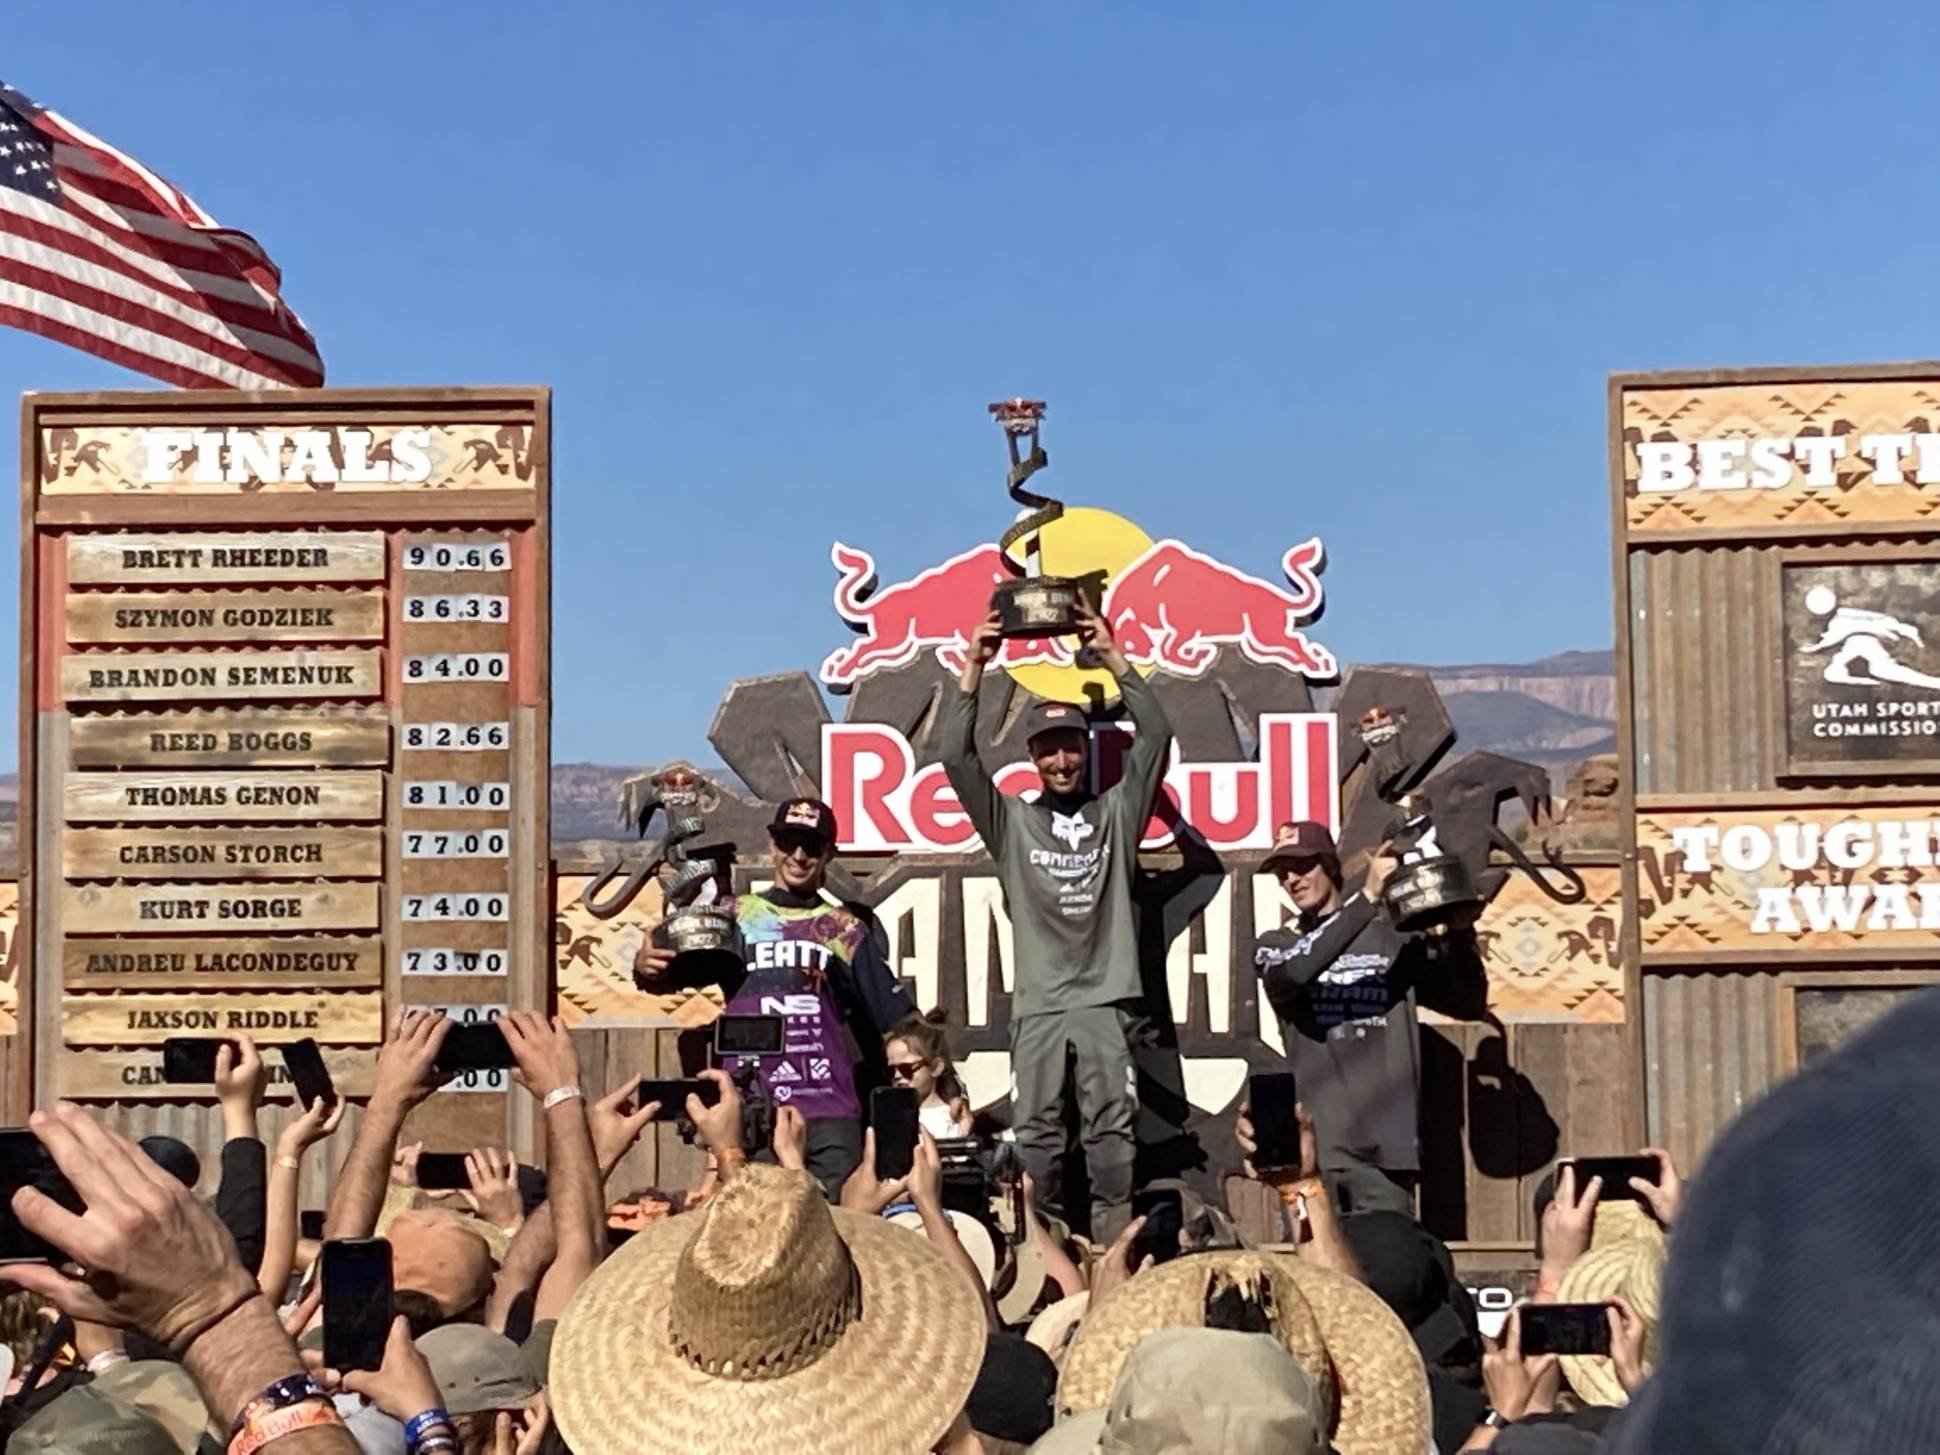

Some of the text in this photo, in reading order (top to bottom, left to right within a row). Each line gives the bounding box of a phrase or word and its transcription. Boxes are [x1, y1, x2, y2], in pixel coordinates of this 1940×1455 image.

[142, 431, 433, 484] FINALS
[1636, 435, 1847, 492] BEST
[122, 549, 202, 569] BRETT
[212, 547, 329, 568] RHEEDER
[115, 609, 214, 629] SZYMON
[222, 607, 334, 627] GODZIEK
[89, 668, 218, 689] BRANDON
[227, 666, 354, 686] SEMENUK
[1812, 703, 1868, 718] UTAH
[1813, 720, 1940, 737] COMMISSIO
[150, 733, 217, 752] REED
[230, 731, 312, 752] BOGGS
[126, 787, 227, 807] THOMAS
[236, 786, 320, 806] GENON
[119, 844, 216, 864] CARSON
[225, 843, 323, 864] STORCH
[1672, 820, 1940, 873] TOUGH
[139, 900, 210, 920] KURT
[218, 899, 302, 919] SORGE
[84, 953, 185, 973] ANDREU
[194, 952, 360, 972] LACONDEGUY
[746, 940, 834, 972] EATT
[761, 995, 821, 1015] NS
[128, 1009, 319, 1029] JAXSON RIDDLE
